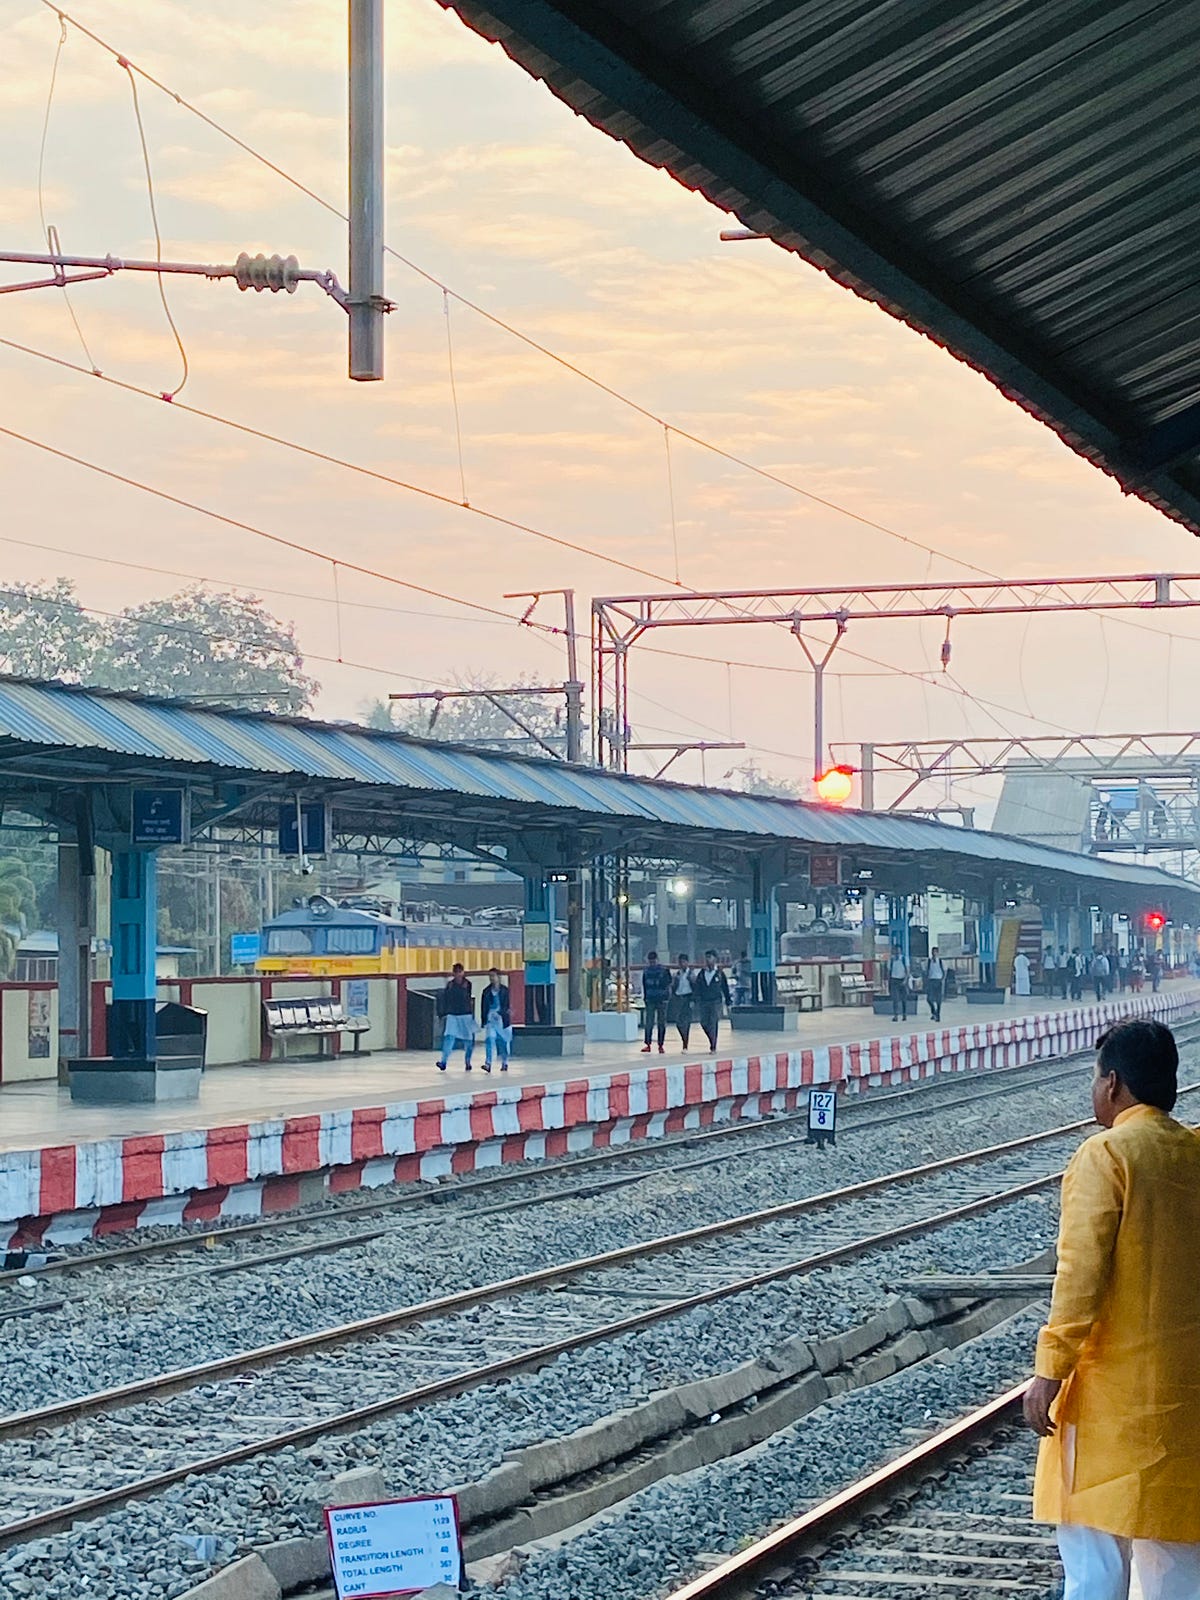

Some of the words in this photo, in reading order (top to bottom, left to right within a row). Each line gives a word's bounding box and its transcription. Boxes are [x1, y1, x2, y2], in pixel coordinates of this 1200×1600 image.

[291, 813, 308, 846] 1
[813, 1094, 832, 1108] 127
[818, 1111, 826, 1125] 8
[334, 1511, 361, 1522] CURVE
[337, 1525, 367, 1535] RADIUS
[338, 1539, 372, 1550] DEGREE
[340, 1552, 389, 1563] TRANSITION
[390, 1547, 424, 1558] LENGTH
[342, 1567, 368, 1578] TOTAL
[369, 1564, 403, 1575] LENGTH
[343, 1582, 366, 1592] CANT
